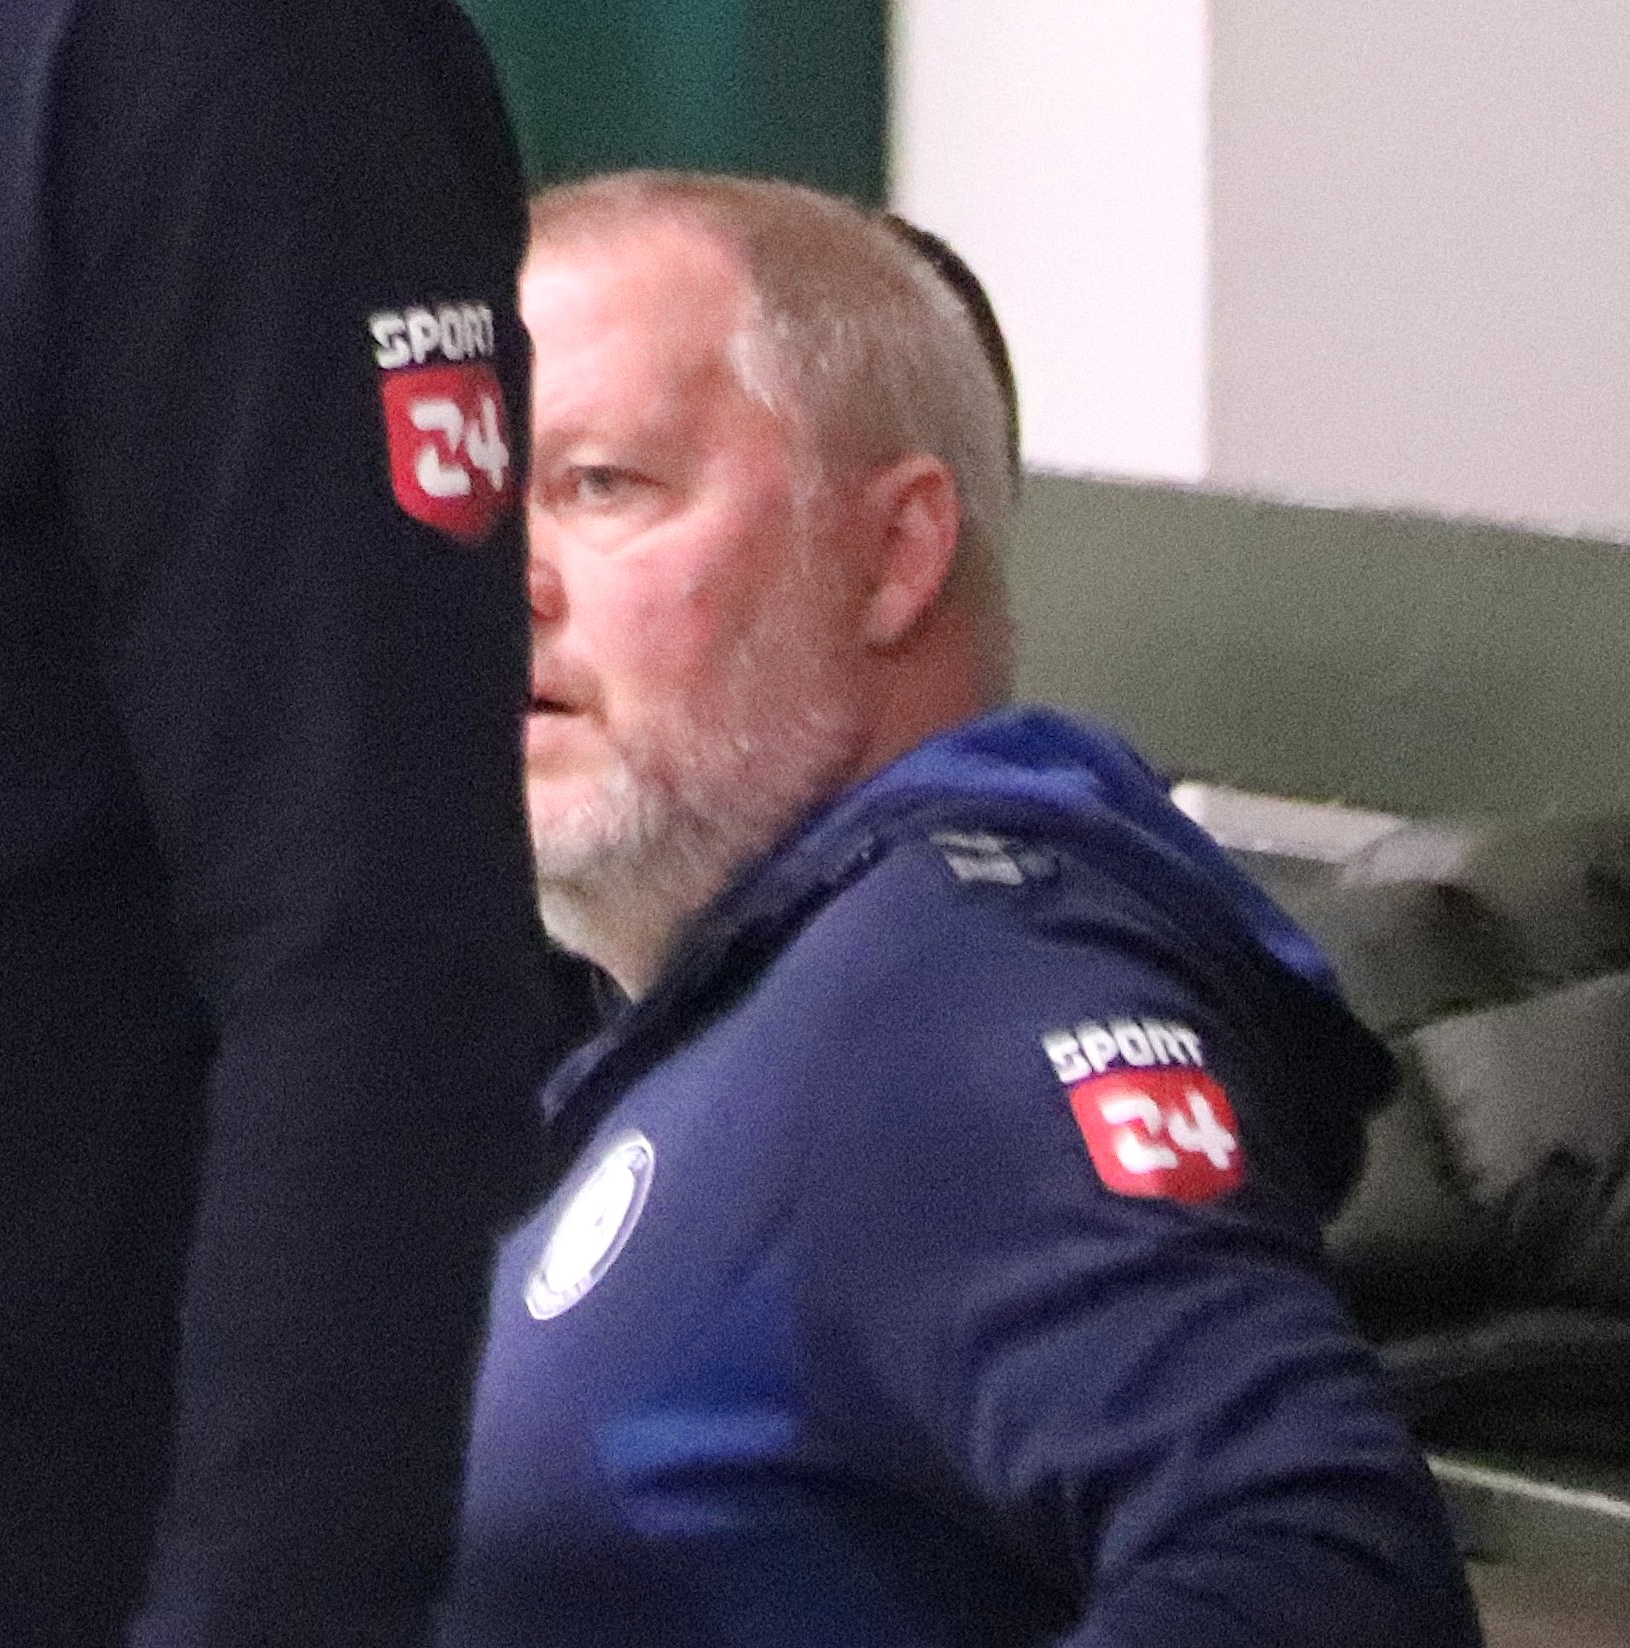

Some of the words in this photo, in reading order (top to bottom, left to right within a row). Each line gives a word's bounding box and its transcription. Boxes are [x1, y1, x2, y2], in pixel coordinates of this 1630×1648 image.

[408, 394, 510, 499] 24
[1042, 1018, 1204, 1084] SPORT
[1100, 1087, 1237, 1174] 24
